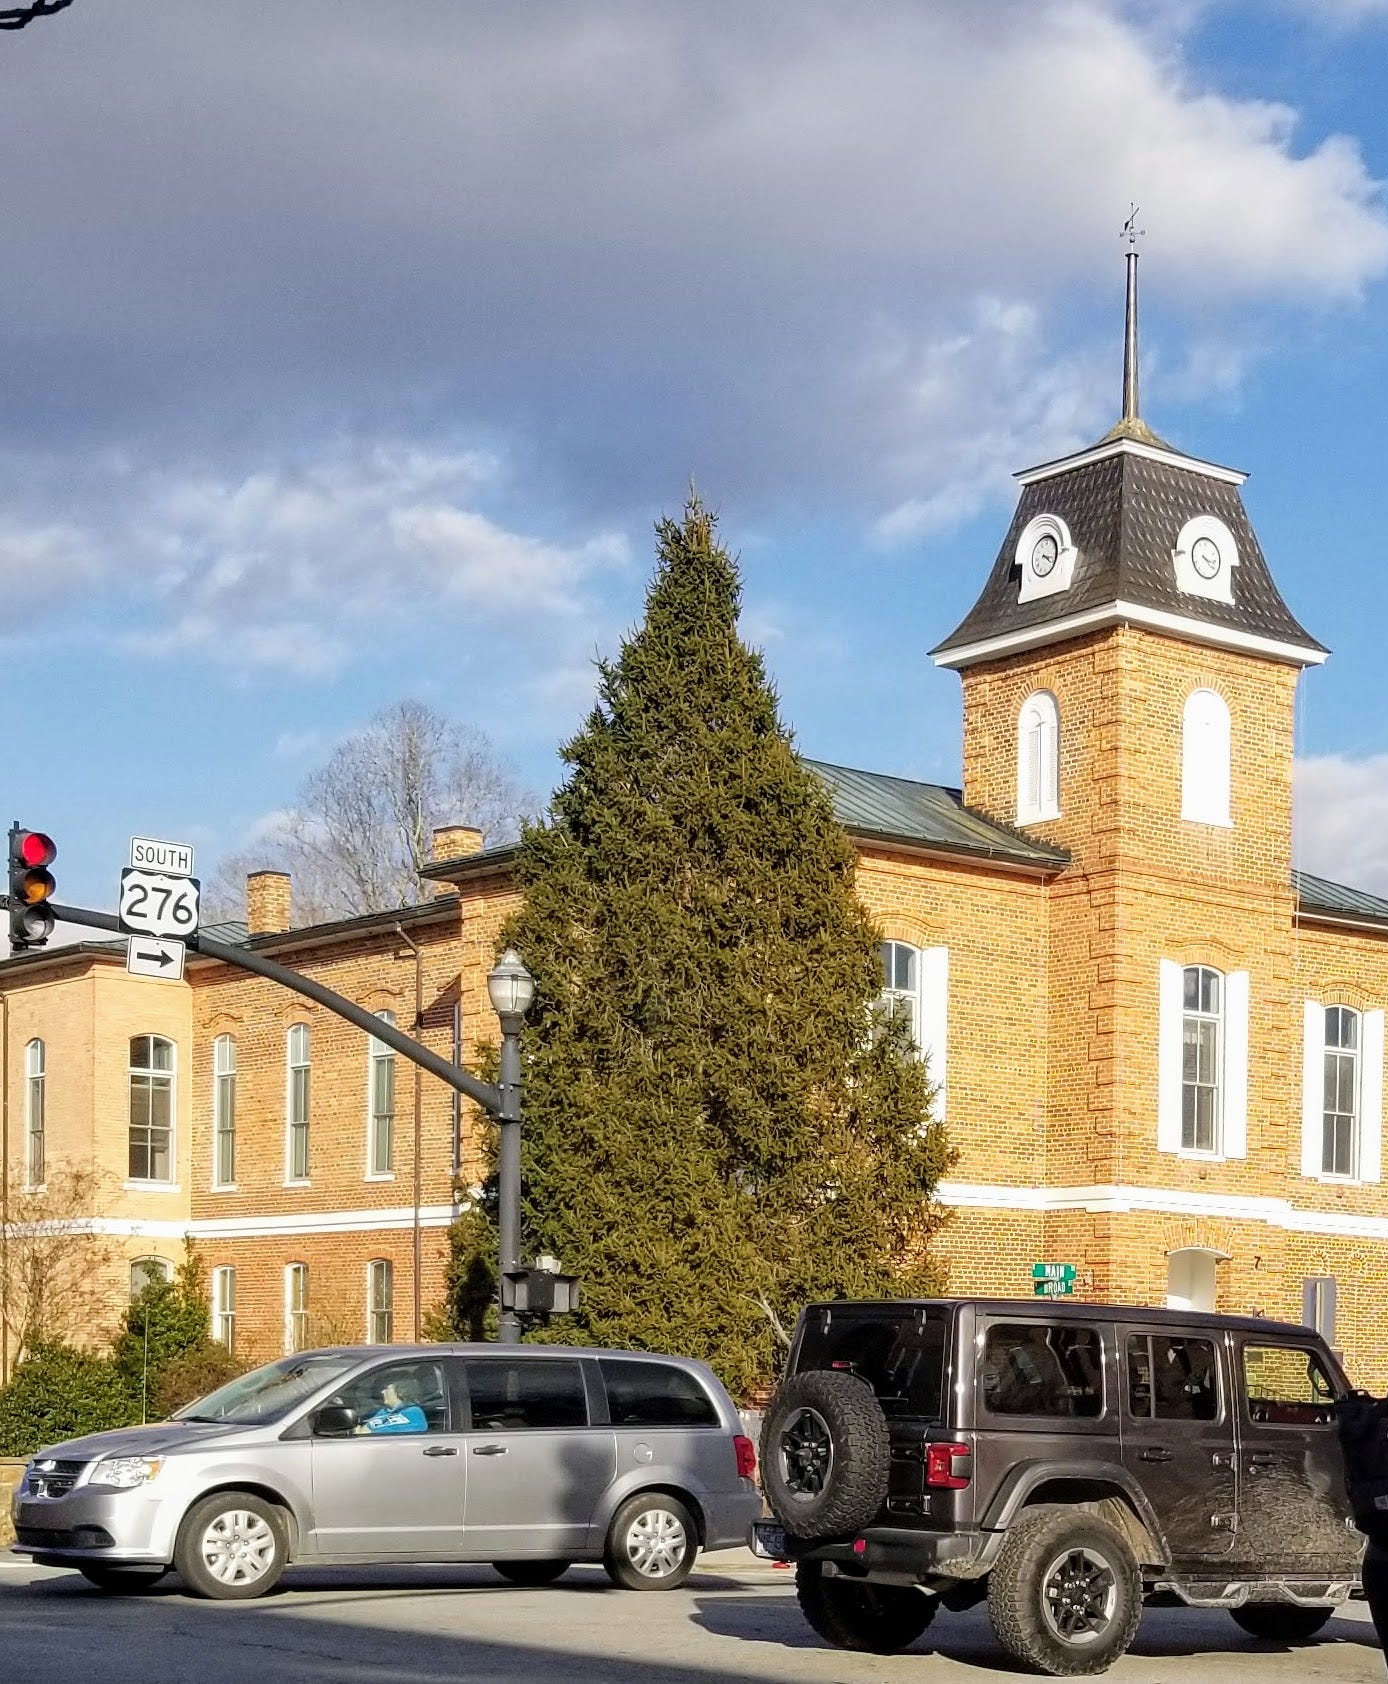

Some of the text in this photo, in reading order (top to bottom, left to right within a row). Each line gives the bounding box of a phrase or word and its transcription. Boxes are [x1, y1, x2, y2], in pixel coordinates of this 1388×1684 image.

[135, 845, 188, 869] SOUTH
[126, 883, 193, 925] 276
[1254, 1255, 1261, 1269] 7
[1044, 1264, 1065, 1278] MAIN
[1043, 1281, 1066, 1294] BROAD
